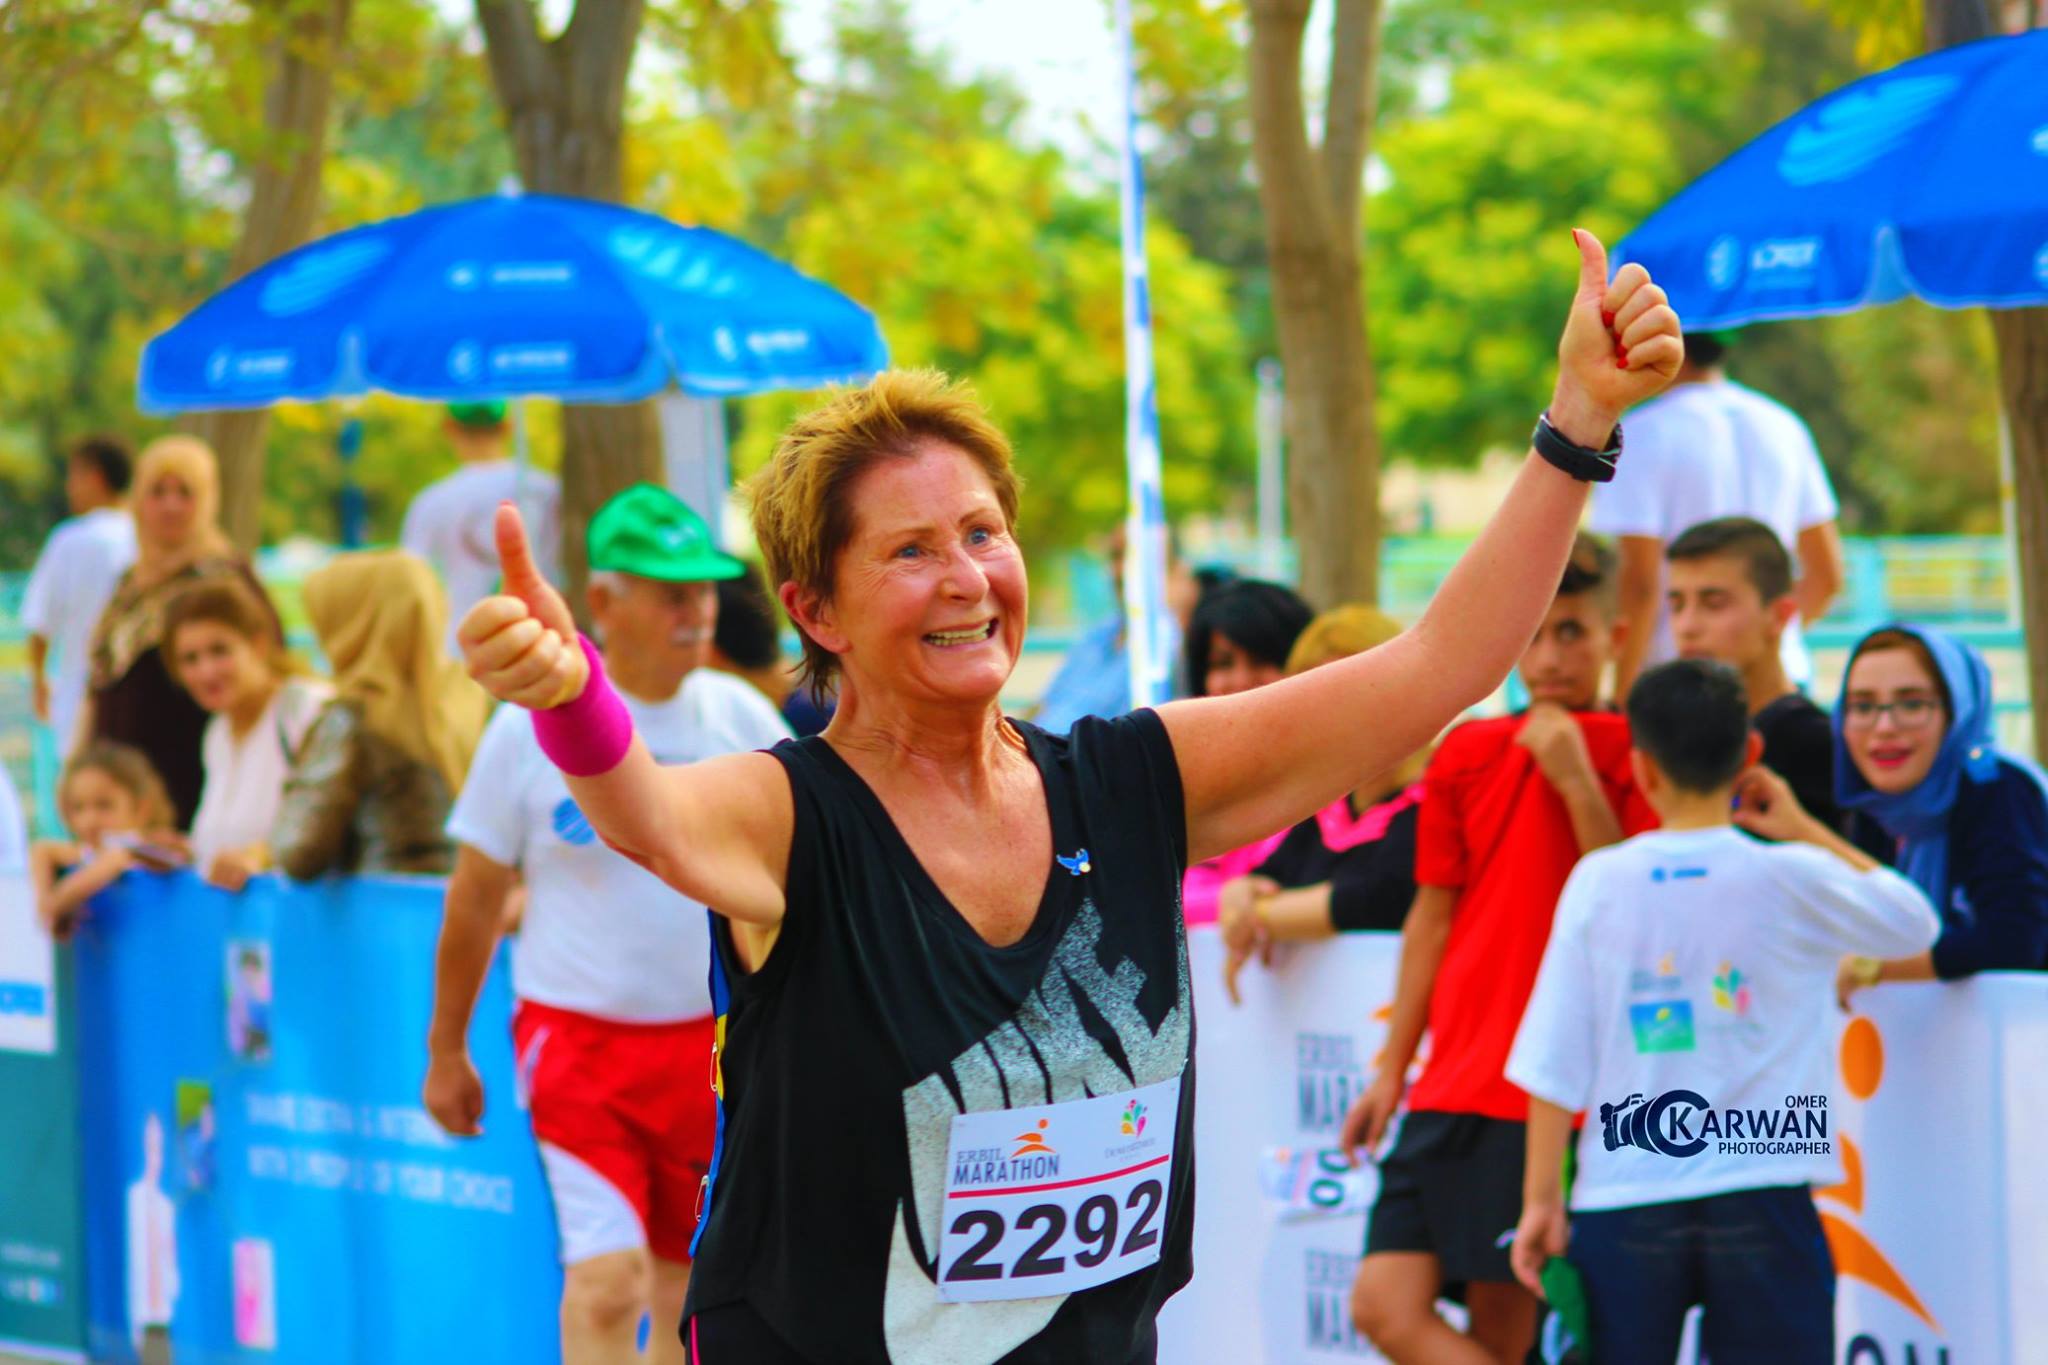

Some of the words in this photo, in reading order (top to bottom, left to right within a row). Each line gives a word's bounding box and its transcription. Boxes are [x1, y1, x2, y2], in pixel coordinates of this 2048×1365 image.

[953, 1155, 1060, 1186] MARATHON
[956, 1148, 1004, 1164] ERBIL
[944, 1178, 1163, 1282] 2292
